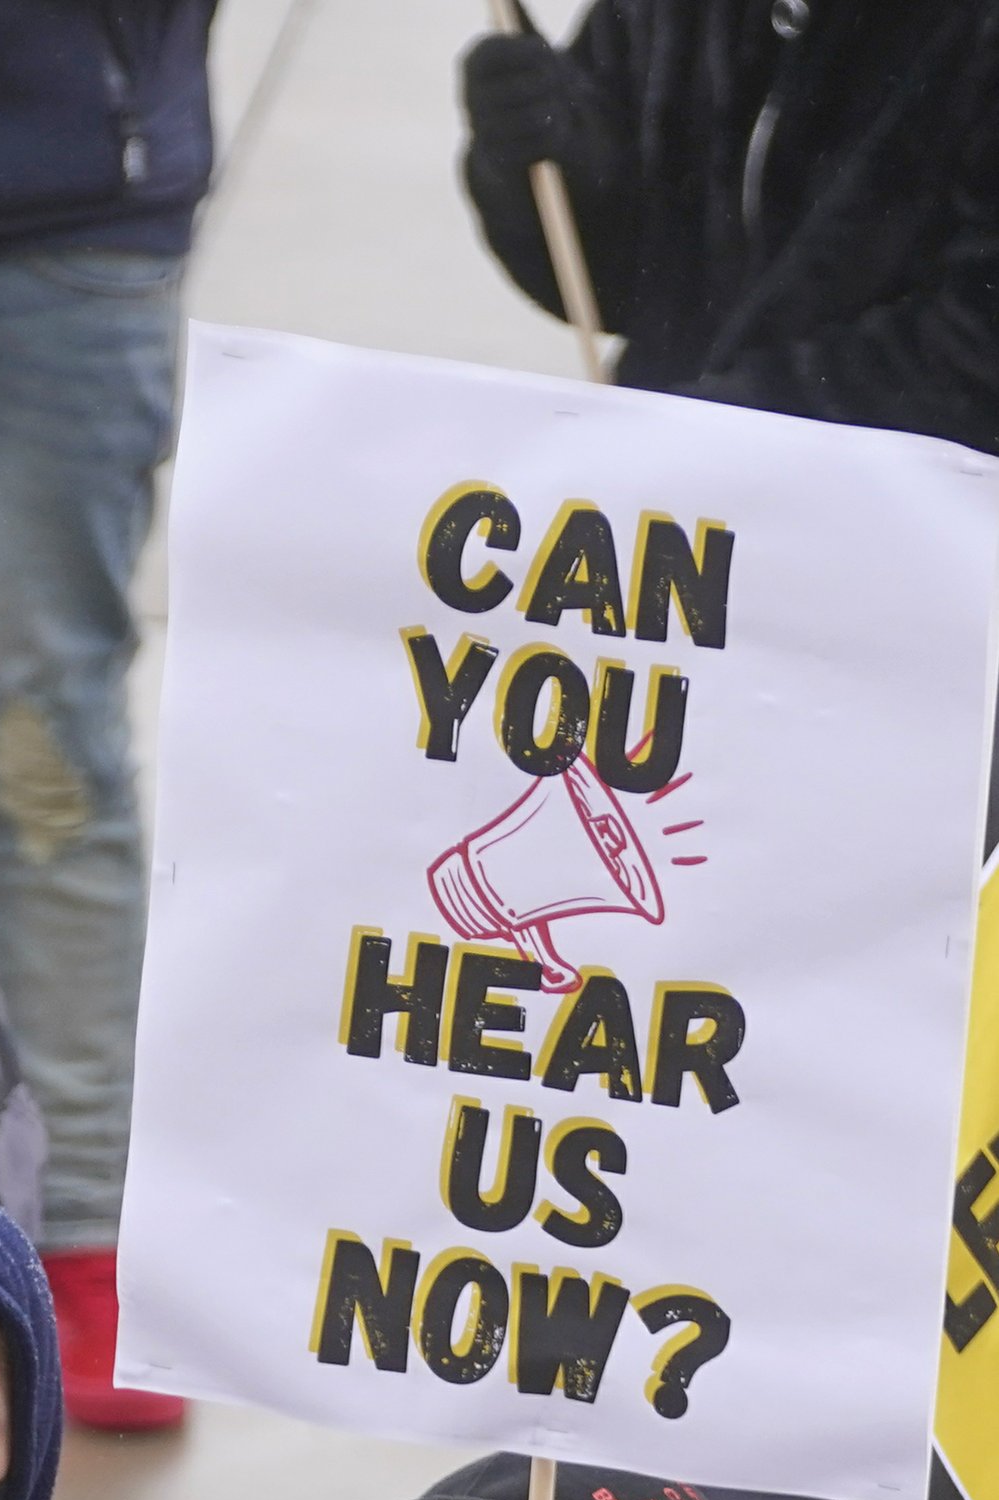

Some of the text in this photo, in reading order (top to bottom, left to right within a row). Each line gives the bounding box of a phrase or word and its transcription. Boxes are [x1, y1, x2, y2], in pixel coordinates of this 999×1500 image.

[416, 478, 736, 650] CAN
[398, 623, 690, 794] YOU
[337, 923, 747, 1115] HEAR
[438, 1093, 628, 1249] US
[307, 1227, 732, 1420] NOW?
